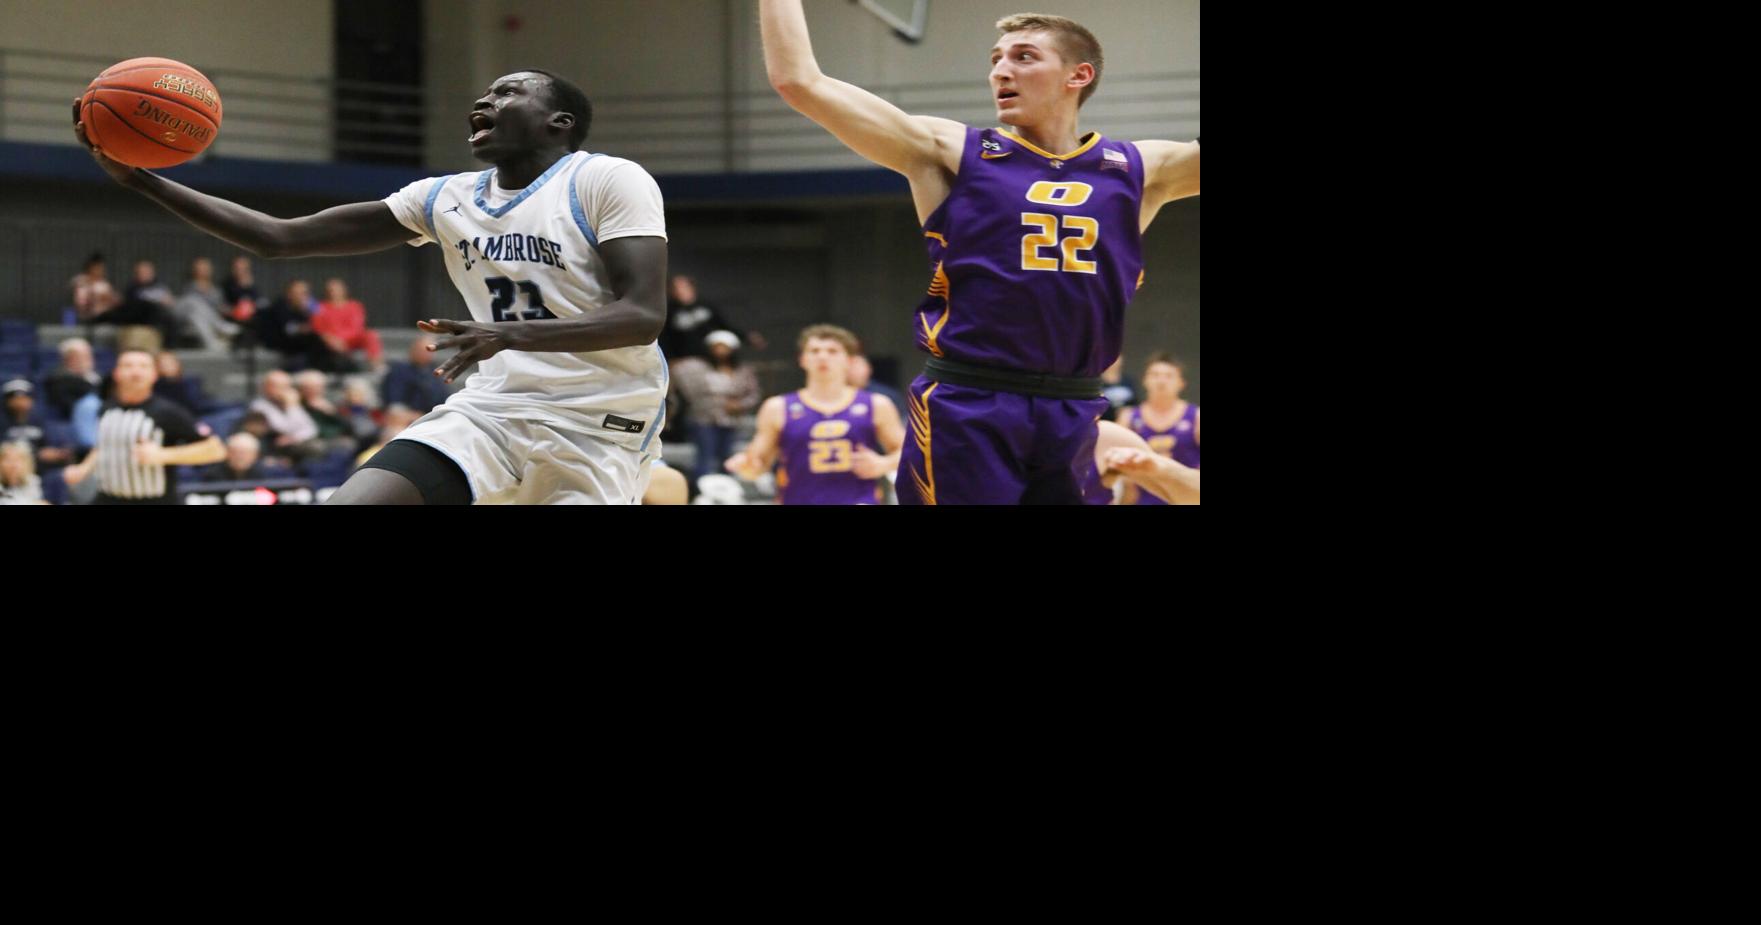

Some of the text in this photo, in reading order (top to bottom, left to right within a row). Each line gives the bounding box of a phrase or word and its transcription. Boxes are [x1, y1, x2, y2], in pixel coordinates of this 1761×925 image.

[133, 98, 213, 144] PALDING
[1021, 212, 1099, 274] 22
[808, 439, 852, 474] 23
